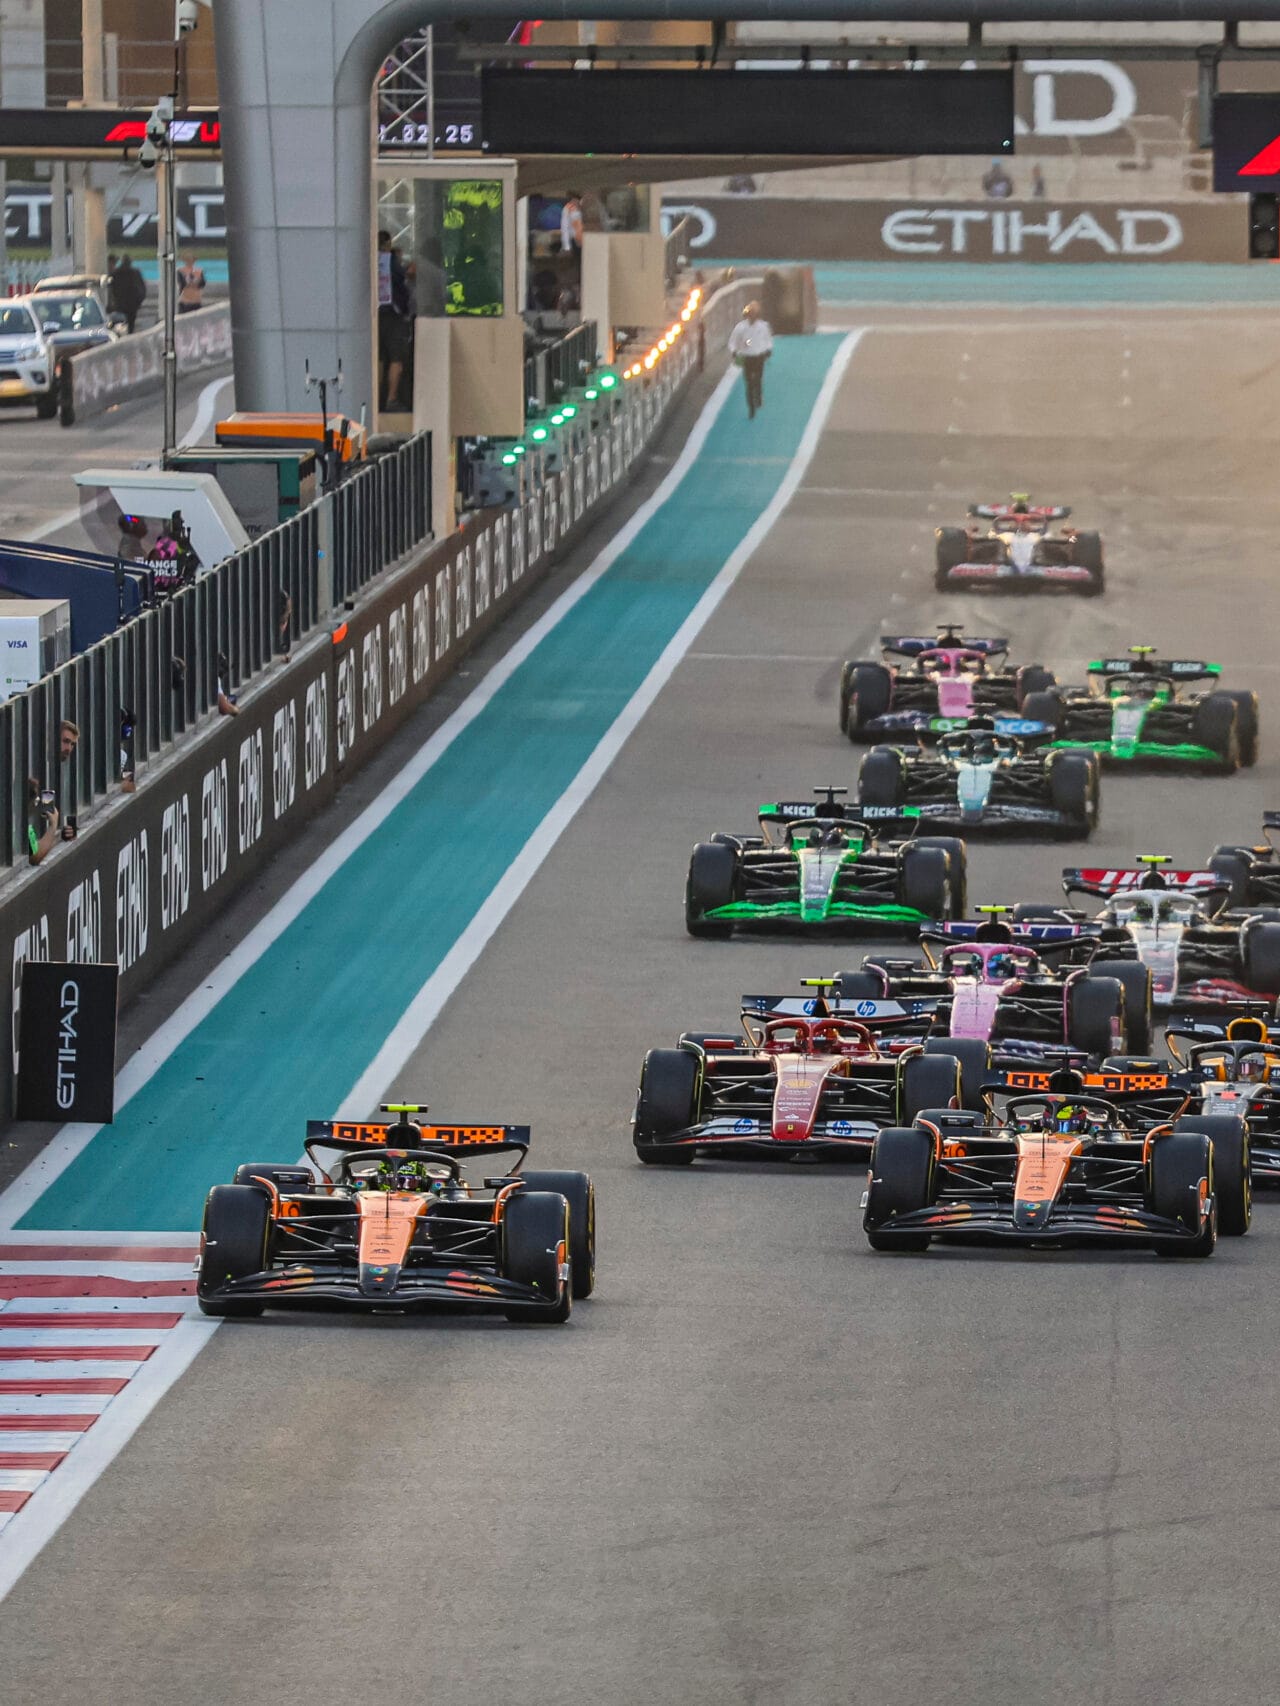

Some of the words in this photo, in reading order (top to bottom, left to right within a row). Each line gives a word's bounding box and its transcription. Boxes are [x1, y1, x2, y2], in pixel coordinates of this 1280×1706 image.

[881, 209, 1183, 254] ETIHAD
[7, 640, 28, 648] VISA
[202, 758, 228, 892] ETIHAD
[783, 805, 815, 816] KICK
[863, 806, 897, 817] KICK
[162, 793, 190, 930] ETIHAD
[116, 828, 149, 976] ETIHAD
[858, 1000, 876, 1016] hp
[57, 980, 79, 1109] ETIHAD
